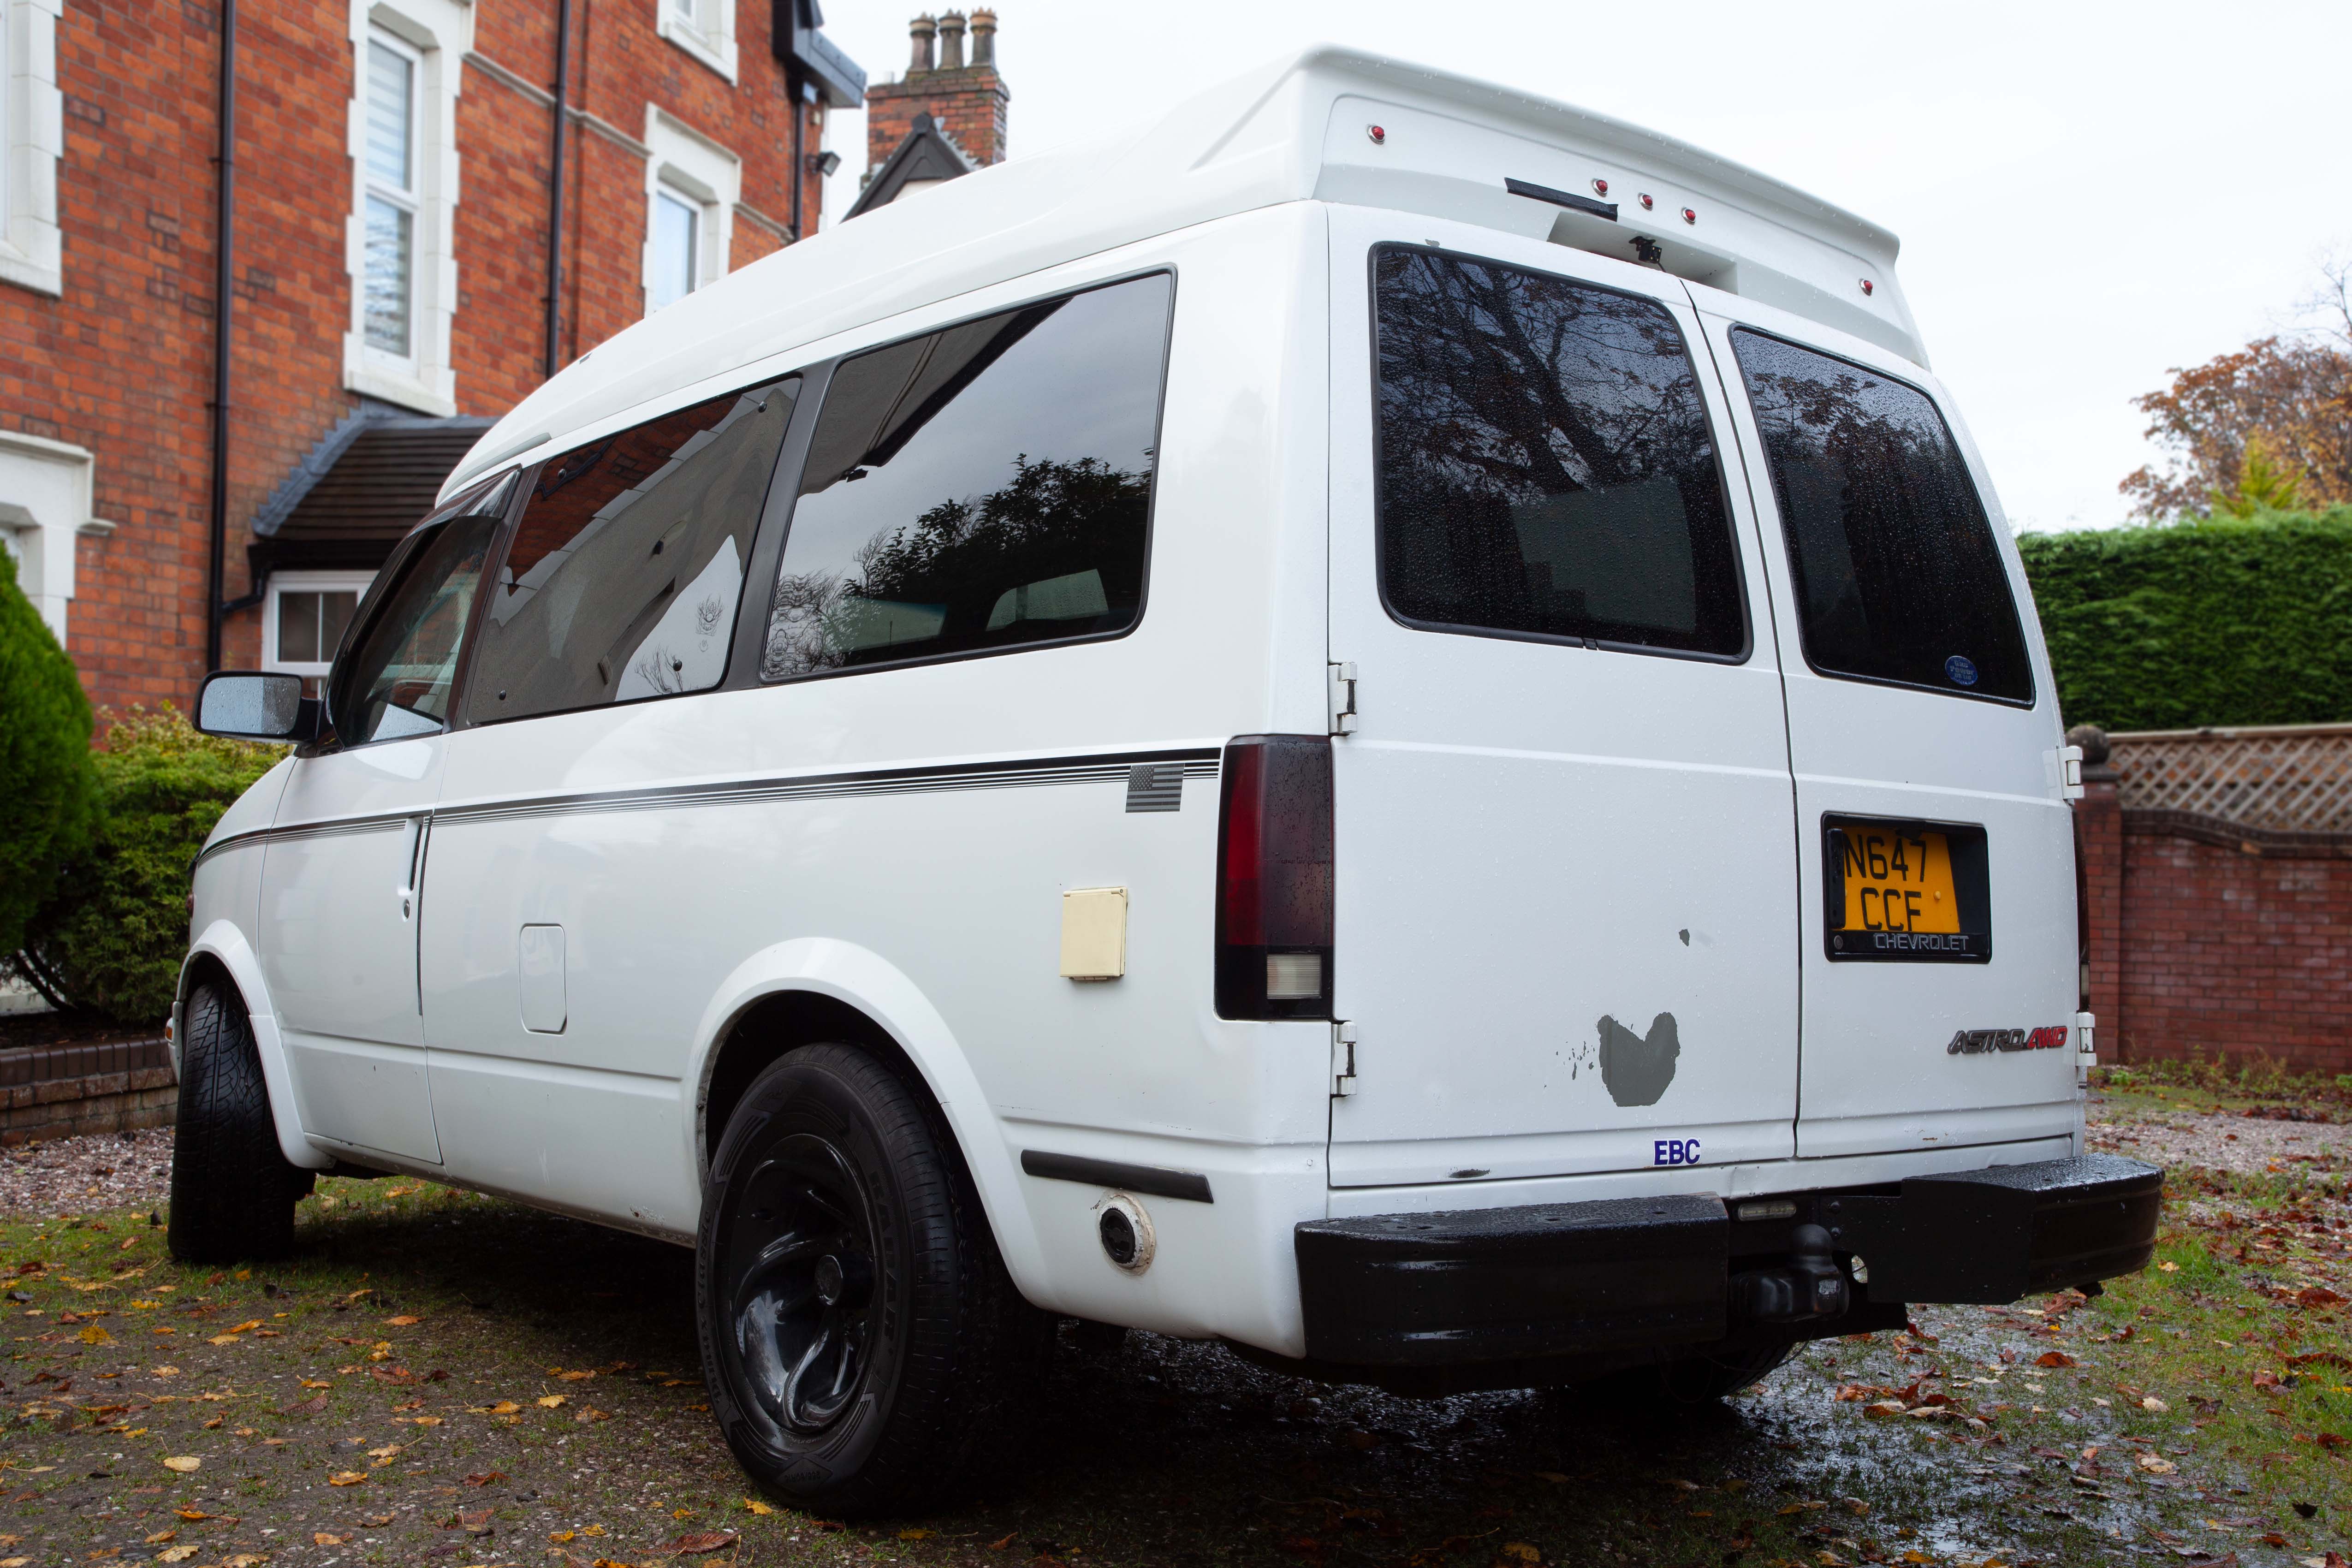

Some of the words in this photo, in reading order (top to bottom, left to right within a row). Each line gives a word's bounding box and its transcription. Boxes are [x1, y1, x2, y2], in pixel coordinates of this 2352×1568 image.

[1843, 832, 1926, 882] N647
[1860, 887, 1922, 931] CCF
[1873, 933, 1969, 950] CHEVROLET
[1947, 1028, 2025, 1054] ASTRO
[2026, 1026, 2068, 1050] AWD
[1654, 1139, 1700, 1165] EBC
